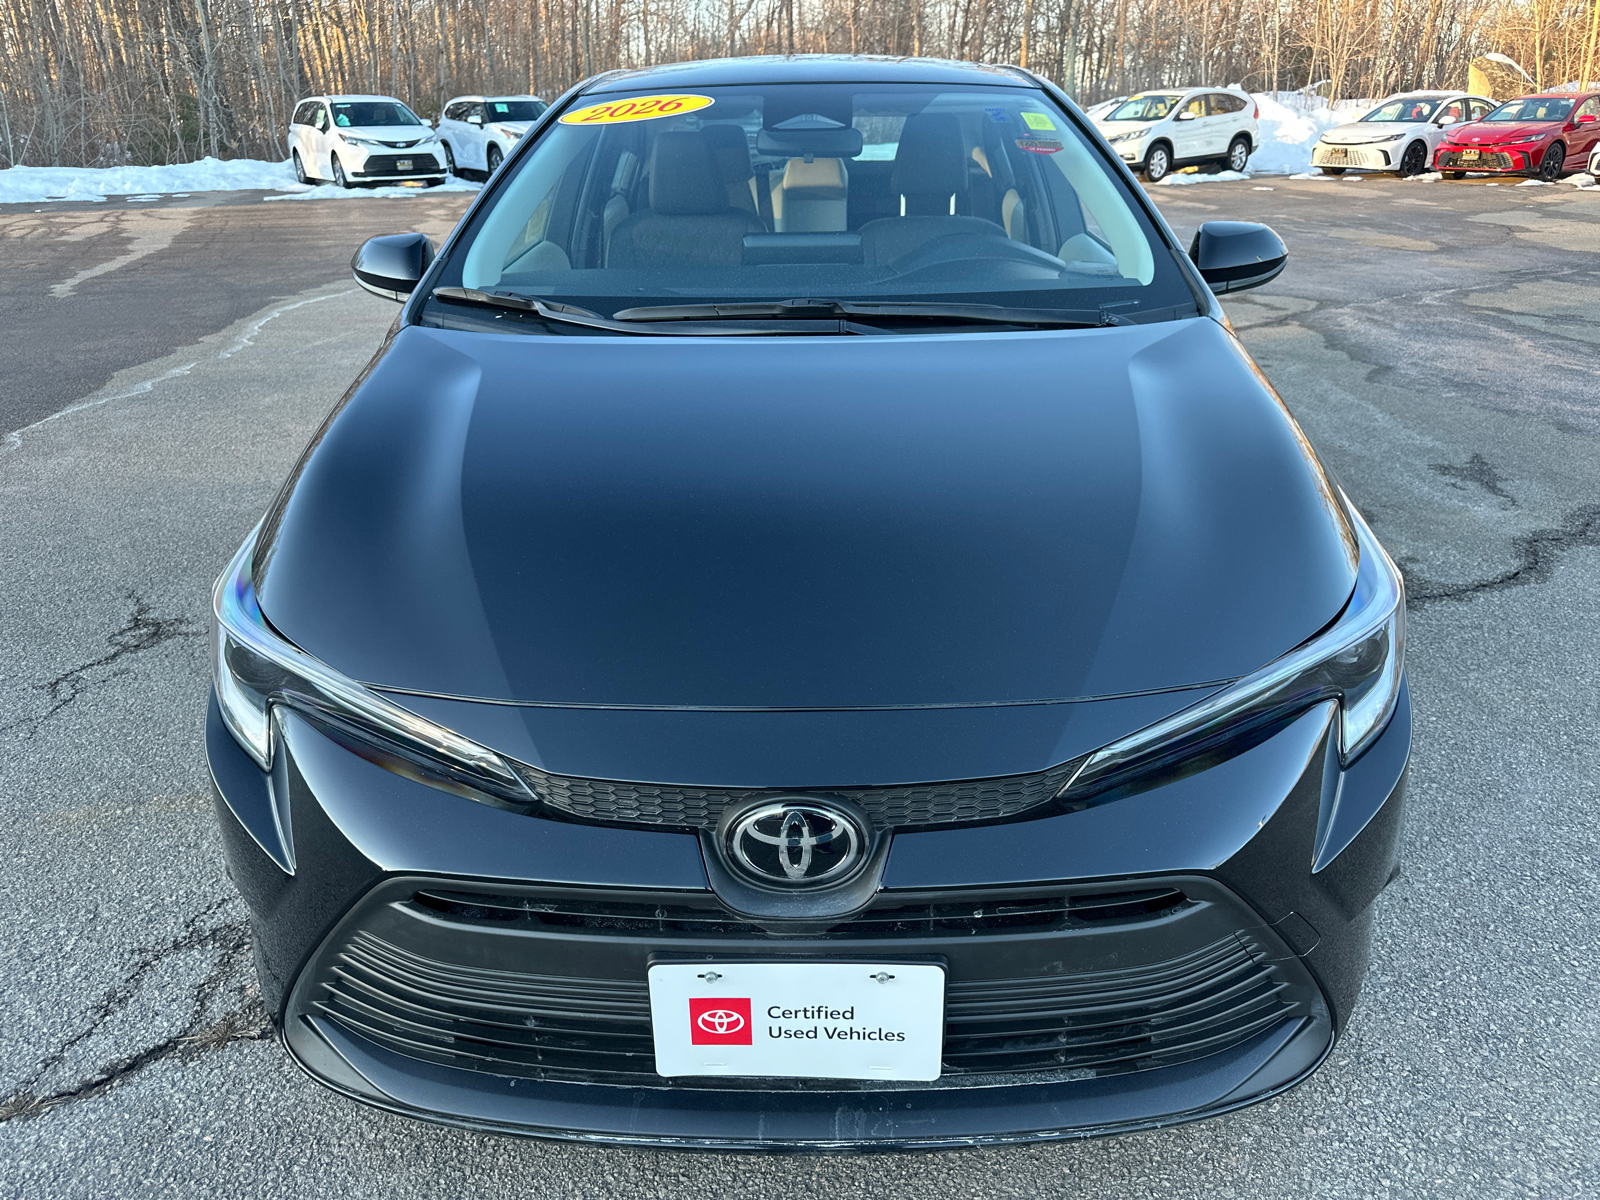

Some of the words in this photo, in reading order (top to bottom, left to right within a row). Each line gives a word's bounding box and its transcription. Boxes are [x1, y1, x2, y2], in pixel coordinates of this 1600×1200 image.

[580, 96, 690, 123] 2026
[767, 1005, 855, 1020] Certified
[768, 1026, 818, 1040] Used
[824, 1027, 906, 1042] Vehicles
